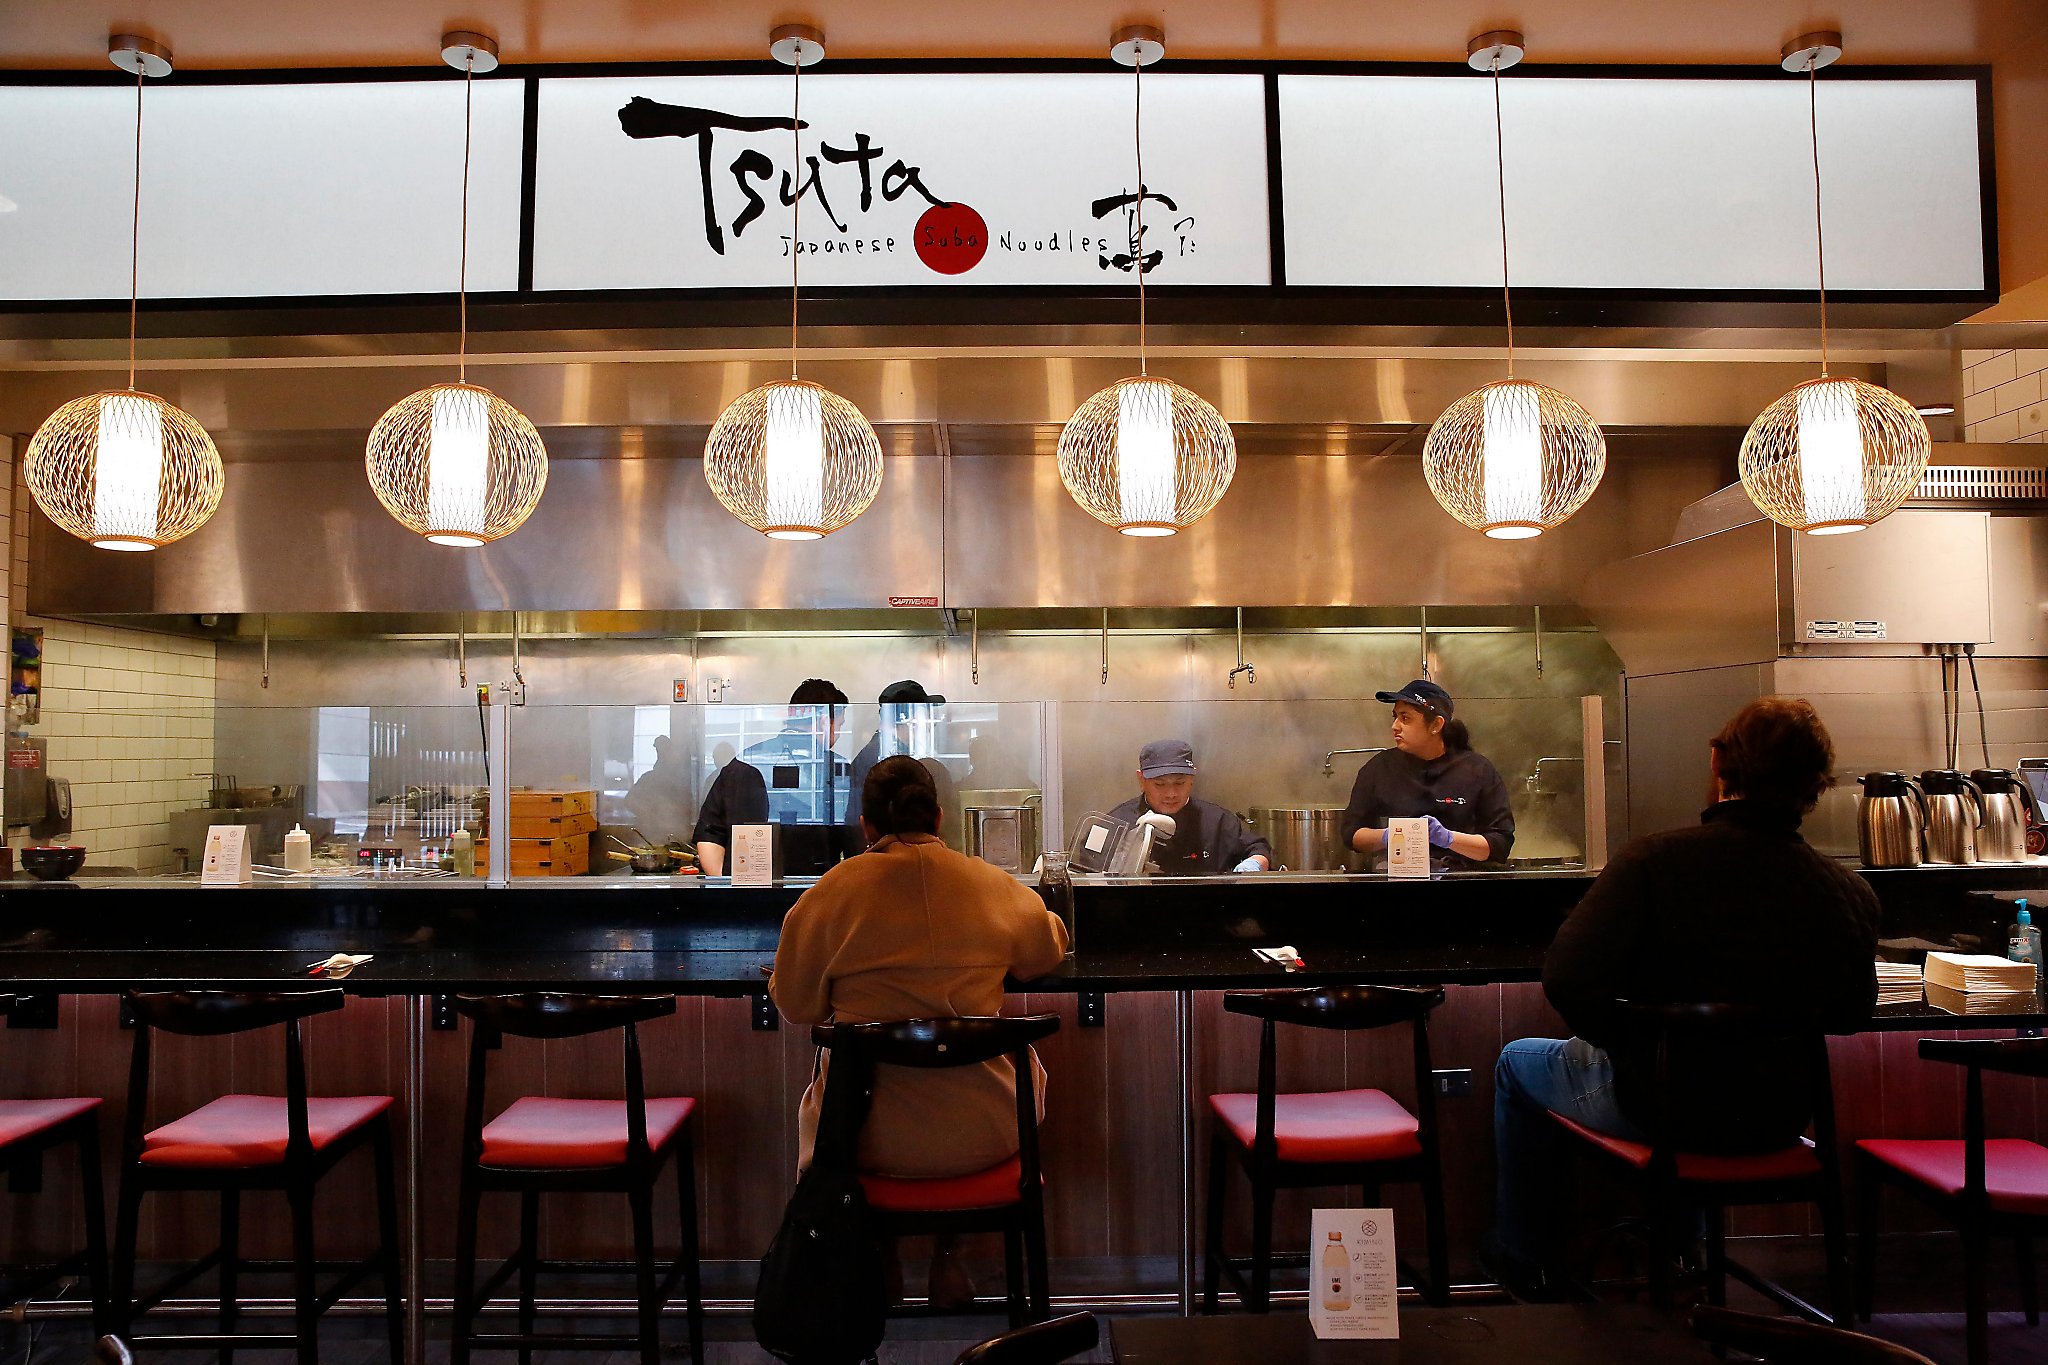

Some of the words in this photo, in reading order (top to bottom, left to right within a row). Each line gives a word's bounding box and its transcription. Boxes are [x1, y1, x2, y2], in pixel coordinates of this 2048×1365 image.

[617, 96, 953, 256] Tsuta
[780, 235, 896, 257] Japanese
[924, 225, 979, 248] Soba
[1000, 229, 1108, 253] Noodles
